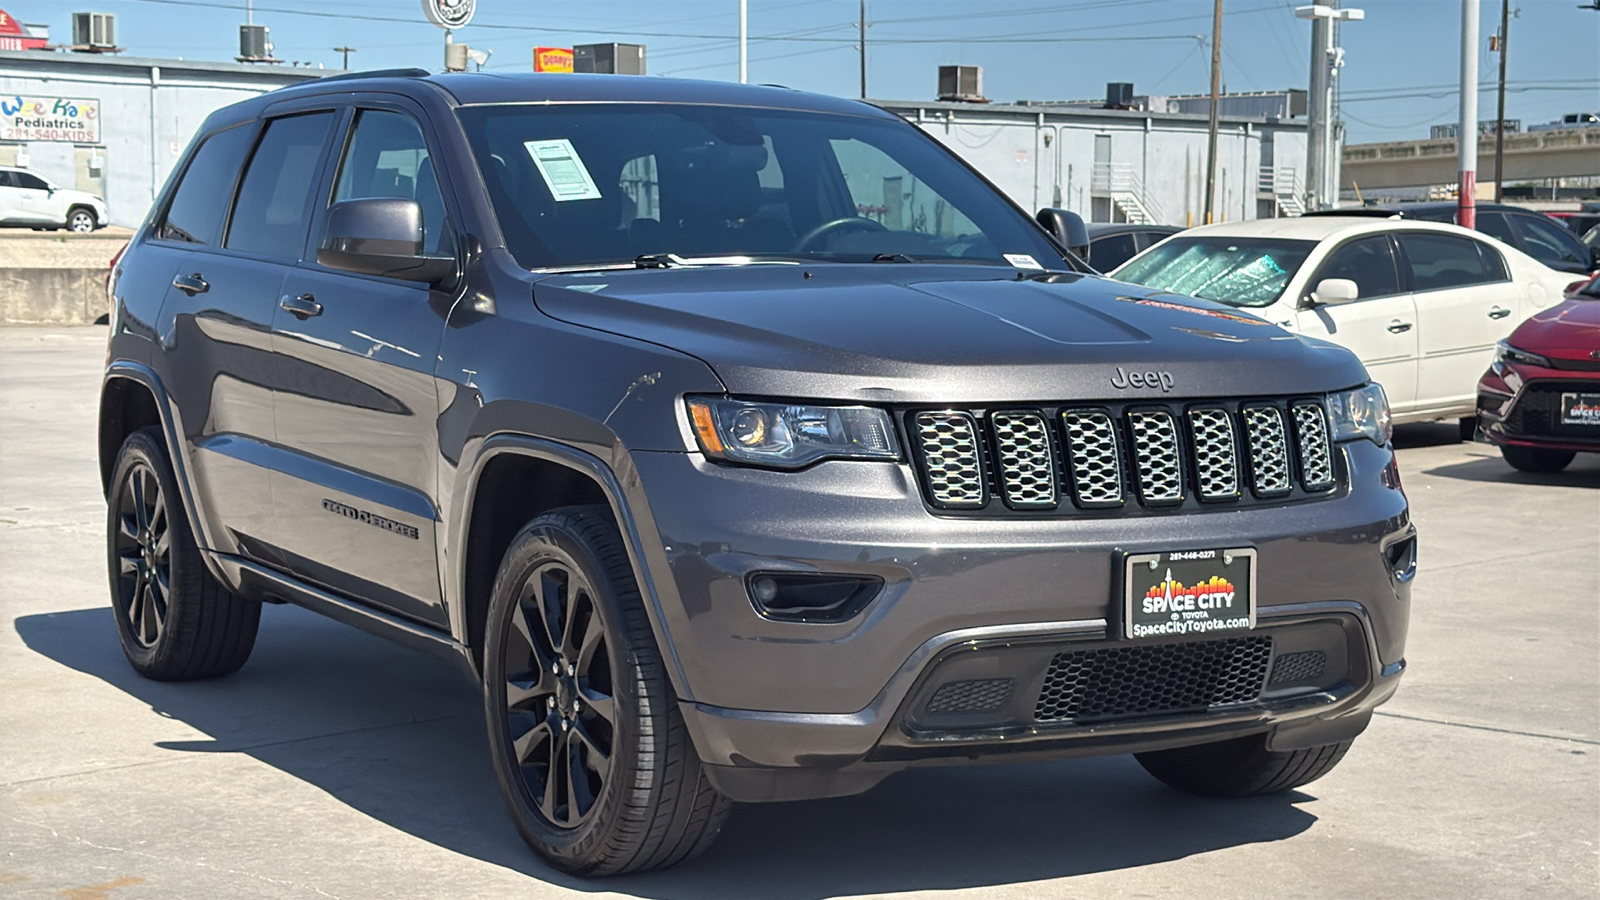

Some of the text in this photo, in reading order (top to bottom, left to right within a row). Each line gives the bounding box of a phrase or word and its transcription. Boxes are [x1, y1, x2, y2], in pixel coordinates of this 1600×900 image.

[1, 95, 97, 120] Wee Kare
[15, 117, 85, 129] Pediatrics
[7, 128, 94, 141] 281-540-KIDS
[1110, 366, 1175, 393] Jeep
[359, 510, 419, 540] CHEROKEE
[1142, 591, 1235, 613] SPACE CITY
[1182, 611, 1209, 620] TOYOTA
[1133, 617, 1250, 637] SpaceCityToyota.com
